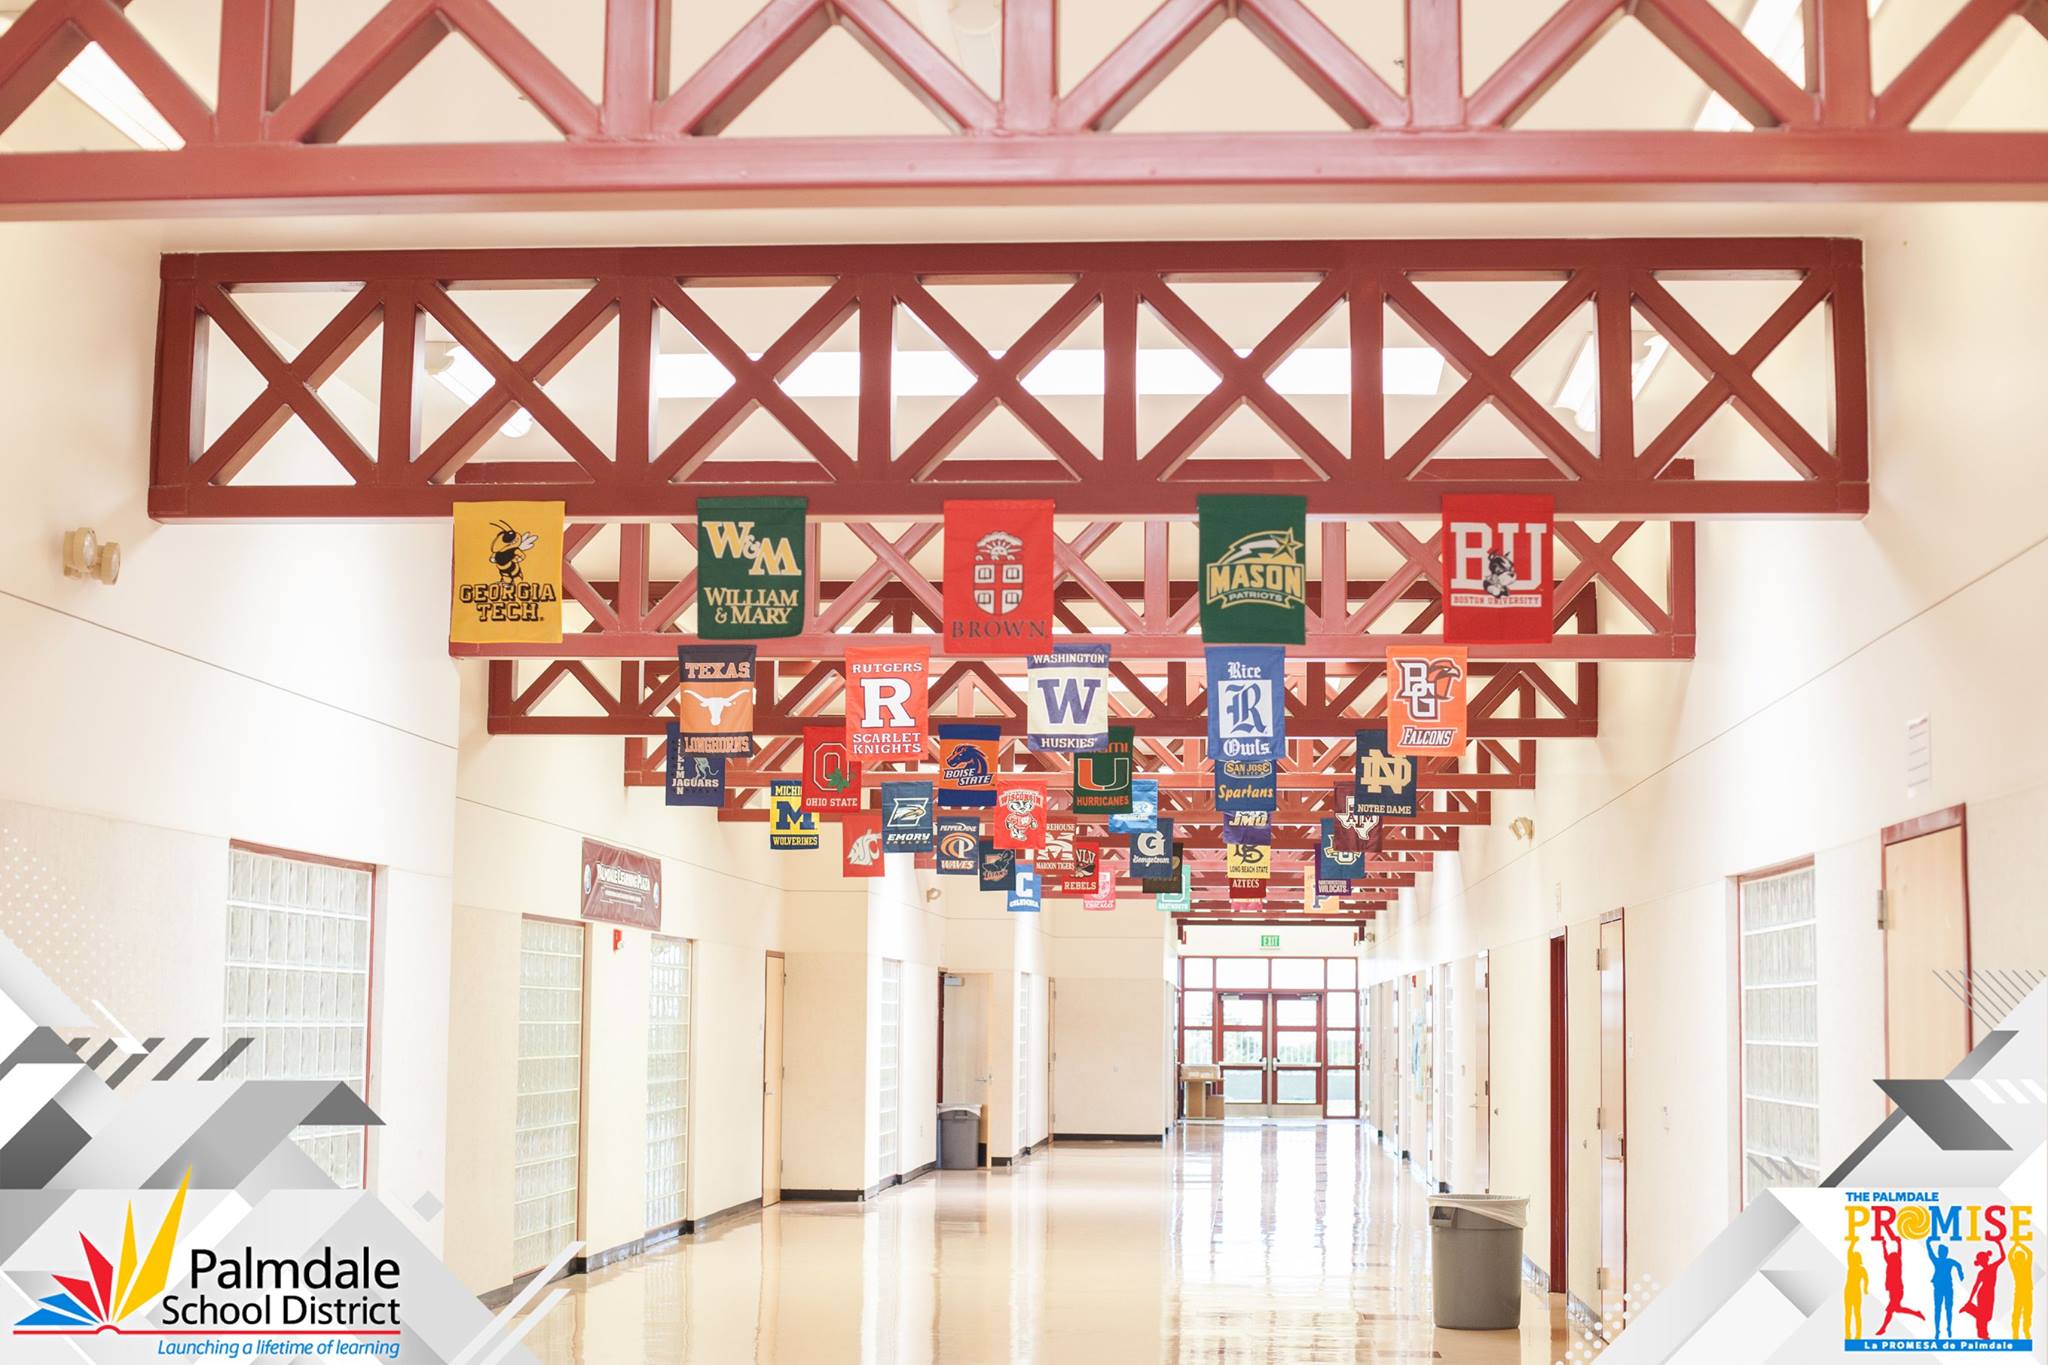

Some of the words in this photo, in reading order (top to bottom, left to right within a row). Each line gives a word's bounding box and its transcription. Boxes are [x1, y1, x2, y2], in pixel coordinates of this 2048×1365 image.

[1451, 522, 1547, 591] BU
[1210, 565, 1301, 593] MASON
[459, 582, 556, 602] GEORGIA
[704, 587, 798, 607] WILLIAM
[1228, 591, 1283, 602] PATRIOTS
[1453, 596, 1484, 604] BOSTON
[1488, 596, 1539, 605] UNIVERSITY
[477, 602, 540, 621] TECH
[715, 609, 727, 622] &
[732, 607, 792, 625] MARY
[951, 620, 1047, 640] BROWN
[1034, 654, 1105, 664] WASHINGTON
[685, 662, 750, 679] TEXAS
[853, 663, 922, 673] RUTGERS
[1227, 662, 1261, 679] Rice
[860, 678, 916, 728] R
[1037, 678, 1101, 724] W
[1225, 684, 1267, 734] R
[853, 732, 920, 743] SCARLET
[1041, 738, 1095, 748] HUSKIES
[1402, 728, 1452, 746] FALCONS
[684, 736, 750, 753] LONGHORNS
[853, 744, 921, 754] KNIGHTS
[1223, 739, 1271, 756] Owls
[945, 768, 975, 779] BOISE
[1078, 757, 1129, 791] U
[672, 779, 719, 787] JAGUARS
[959, 774, 991, 786] STATE
[775, 786, 801, 796] MICHI
[1218, 784, 1273, 801] Spartans
[806, 798, 827, 807] OHIO
[830, 798, 858, 806] STATE
[1077, 796, 1129, 806] HURRICANES
[1358, 804, 1385, 813] NOTRE
[1387, 805, 1411, 814] DAME
[776, 801, 815, 830] M
[1046, 823, 1075, 831] REHOUSE
[773, 837, 817, 846] WOLVERINES
[887, 833, 930, 841] EMORY
[1138, 831, 1165, 856] G
[941, 861, 974, 869] WAVES
[1133, 855, 1169, 867] Georgetown
[1016, 872, 1033, 898] C
[1064, 882, 1096, 890] REBELS
[1232, 879, 1259, 888] AZTECS
[1319, 885, 1347, 893] WILDCATS
[1264, 936, 1278, 946] EXIT
